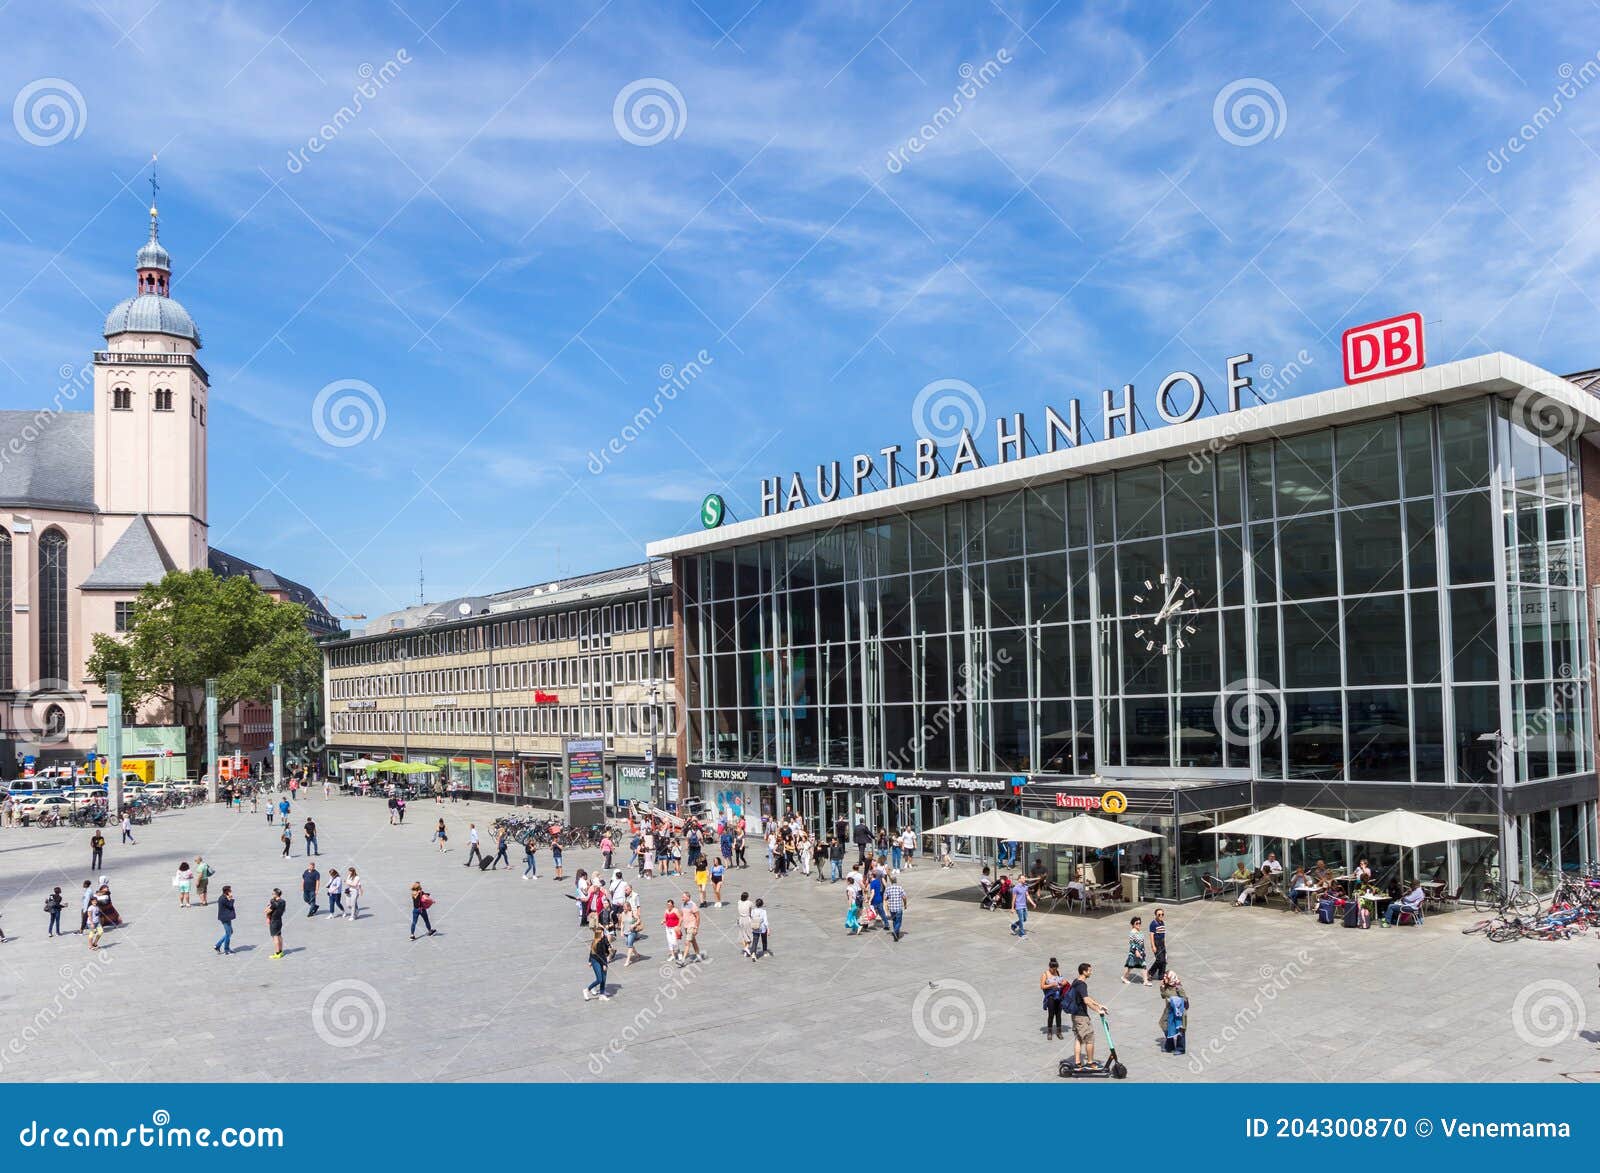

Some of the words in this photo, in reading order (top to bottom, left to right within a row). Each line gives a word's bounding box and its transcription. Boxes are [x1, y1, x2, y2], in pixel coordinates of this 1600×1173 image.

[1352, 325, 1412, 375] DB
[761, 353, 1253, 517] HAUPTBAHNHOF
[704, 498, 718, 525] S
[622, 767, 646, 778] CHANGE
[701, 769, 713, 778] THE
[714, 770, 730, 779] BODY
[731, 771, 748, 780] SHOP
[1055, 793, 1100, 811] Kamps
